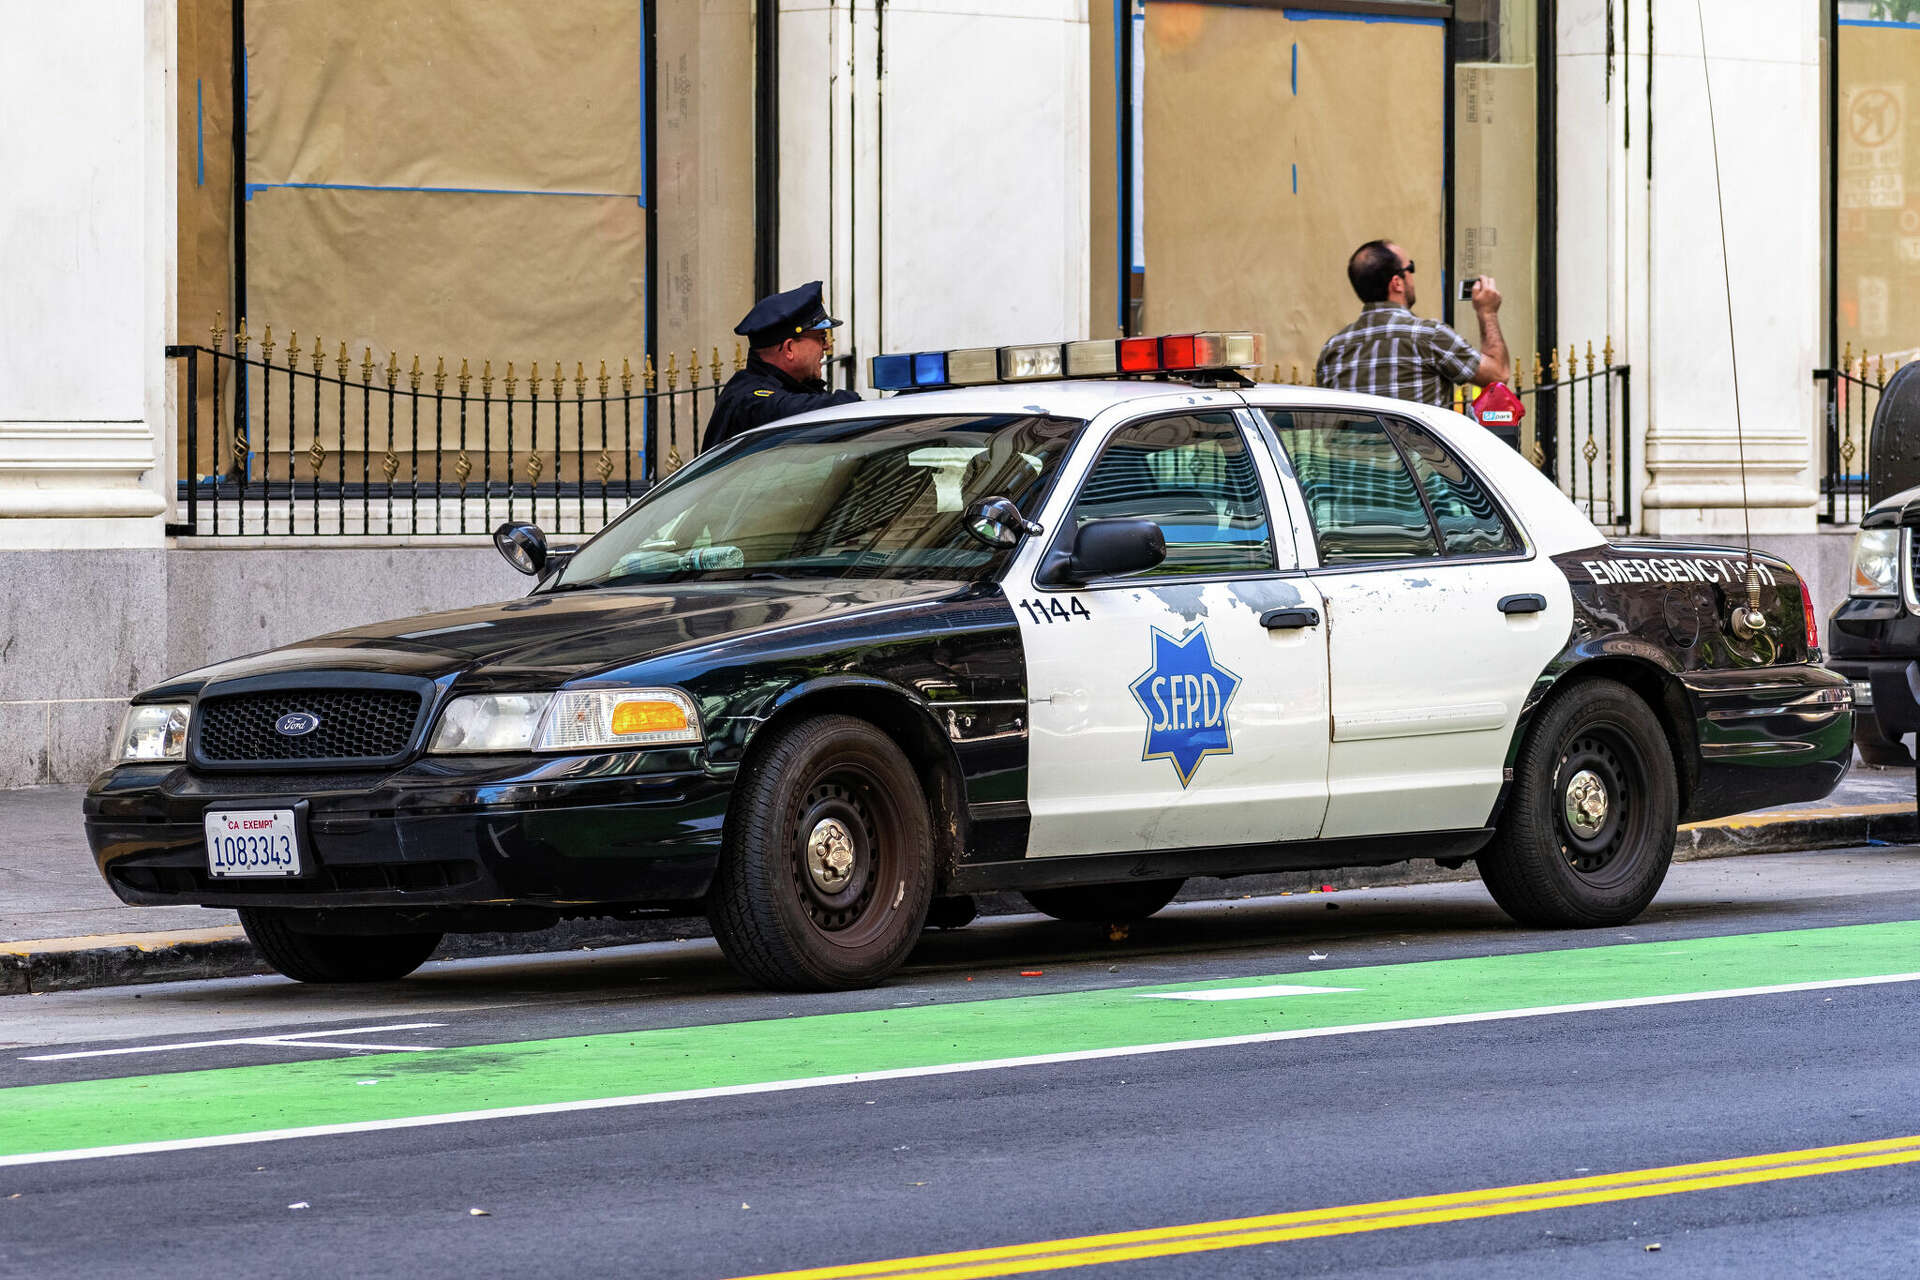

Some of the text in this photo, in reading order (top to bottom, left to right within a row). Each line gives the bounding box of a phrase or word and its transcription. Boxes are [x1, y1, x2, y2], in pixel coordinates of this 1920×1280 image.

[1581, 558, 1732, 585] EMERGENCY
[1019, 595, 1092, 624] 1144
[284, 716, 307, 730] Ford
[227, 819, 274, 831] CA EXEMPT
[214, 835, 292, 867] 1083343
